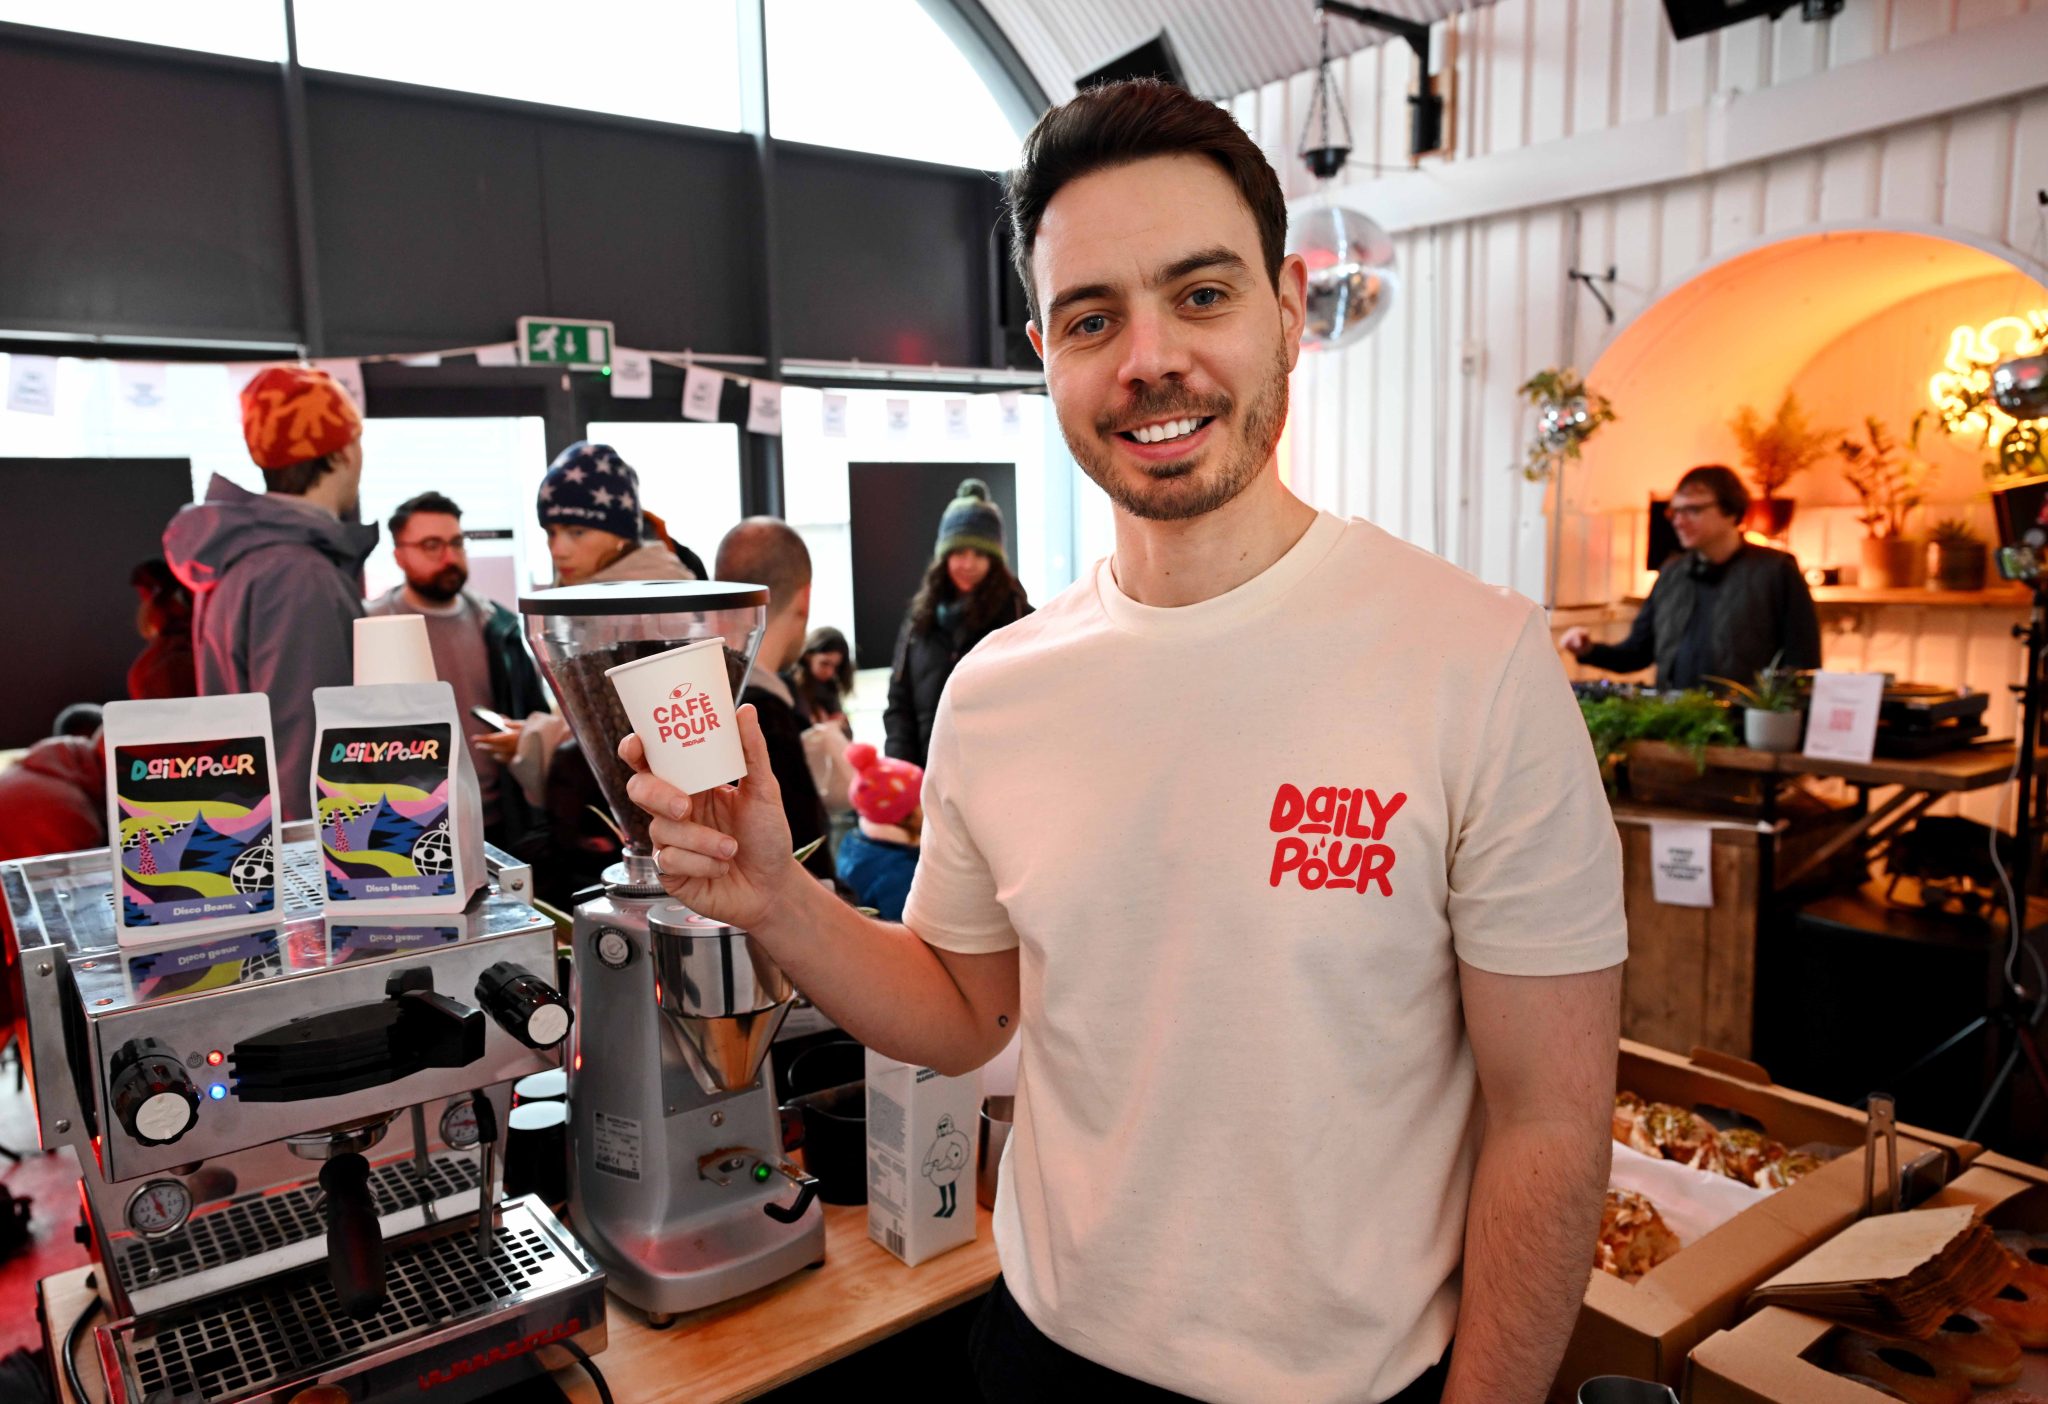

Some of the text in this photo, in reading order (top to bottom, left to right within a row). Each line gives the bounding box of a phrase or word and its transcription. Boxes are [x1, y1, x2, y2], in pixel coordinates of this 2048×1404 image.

[658, 712, 721, 743] POUR
[365, 882, 420, 893] Disco Beans.
[173, 902, 237, 917] Disco Beans.
